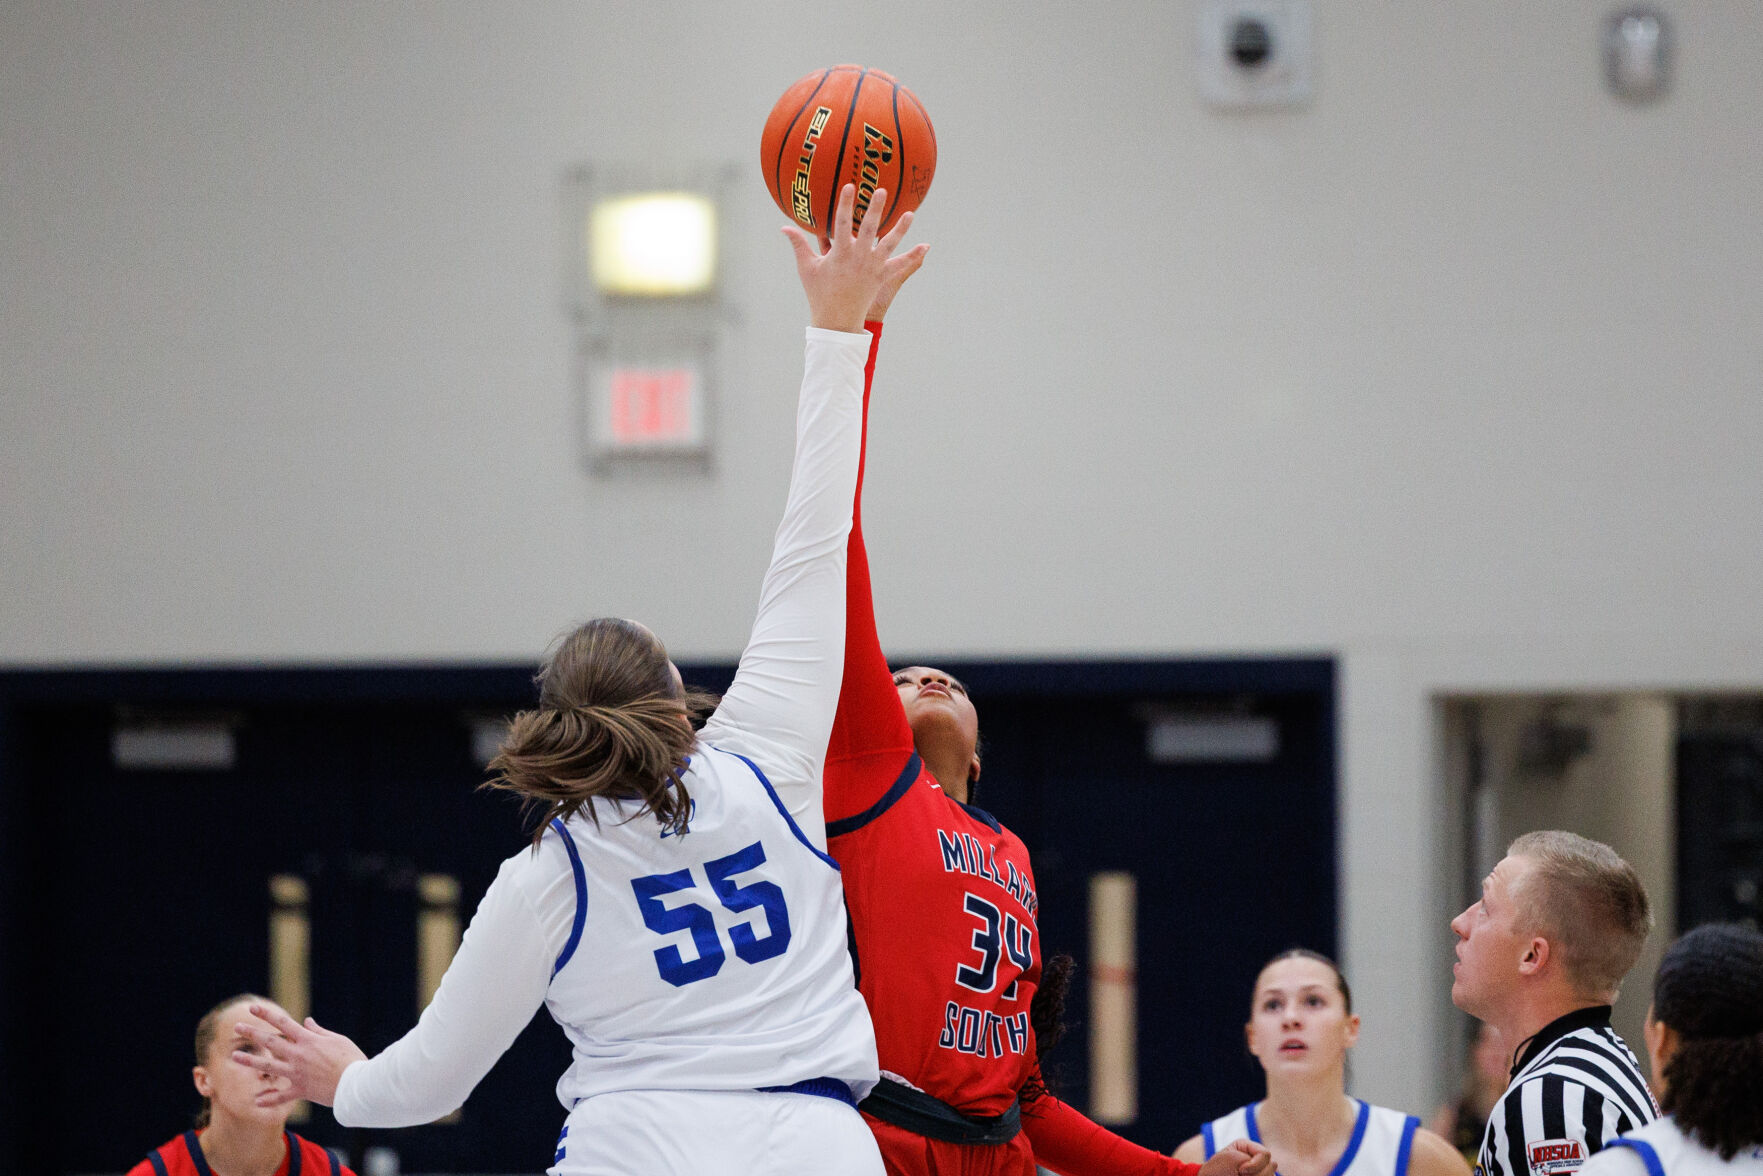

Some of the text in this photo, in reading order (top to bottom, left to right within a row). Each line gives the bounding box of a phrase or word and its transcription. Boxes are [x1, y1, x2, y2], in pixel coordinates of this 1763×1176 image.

[793, 106, 832, 226] ELITE PRO
[630, 840, 792, 987] 55
[937, 829, 1039, 931] MILLAR
[955, 891, 1032, 1001] 34
[939, 1000, 1028, 1058] SOUTH
